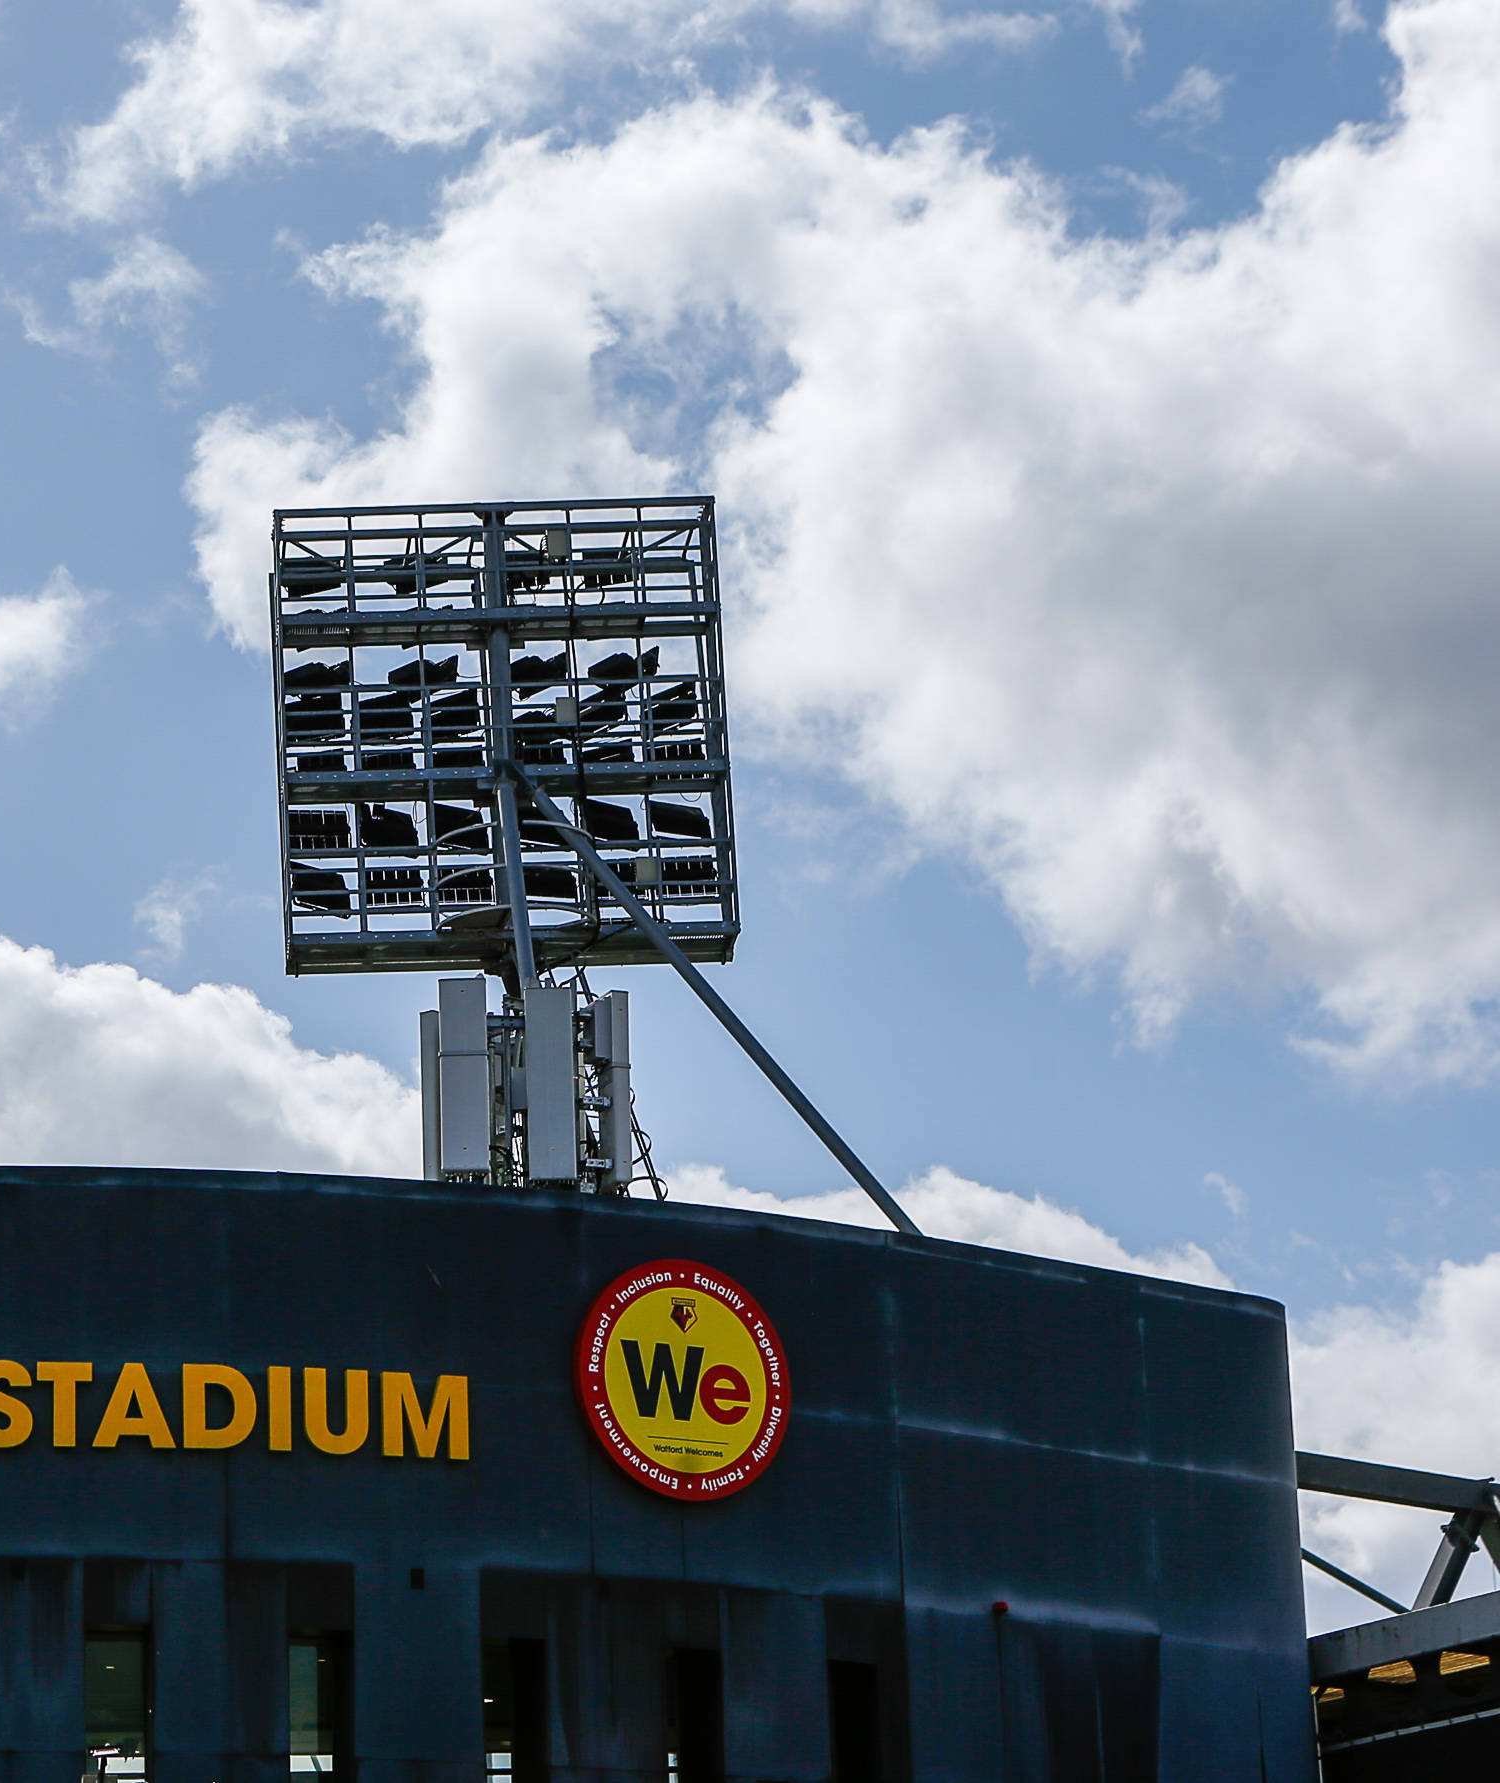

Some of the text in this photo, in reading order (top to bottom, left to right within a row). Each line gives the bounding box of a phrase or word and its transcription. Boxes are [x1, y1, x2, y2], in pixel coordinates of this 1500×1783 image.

[588, 1272, 782, 1491] Inclusion Equality Together Diversity Family Empowerment Respect
[620, 1339, 751, 1426] We
[653, 1443, 724, 1458] Watford Welcomes
